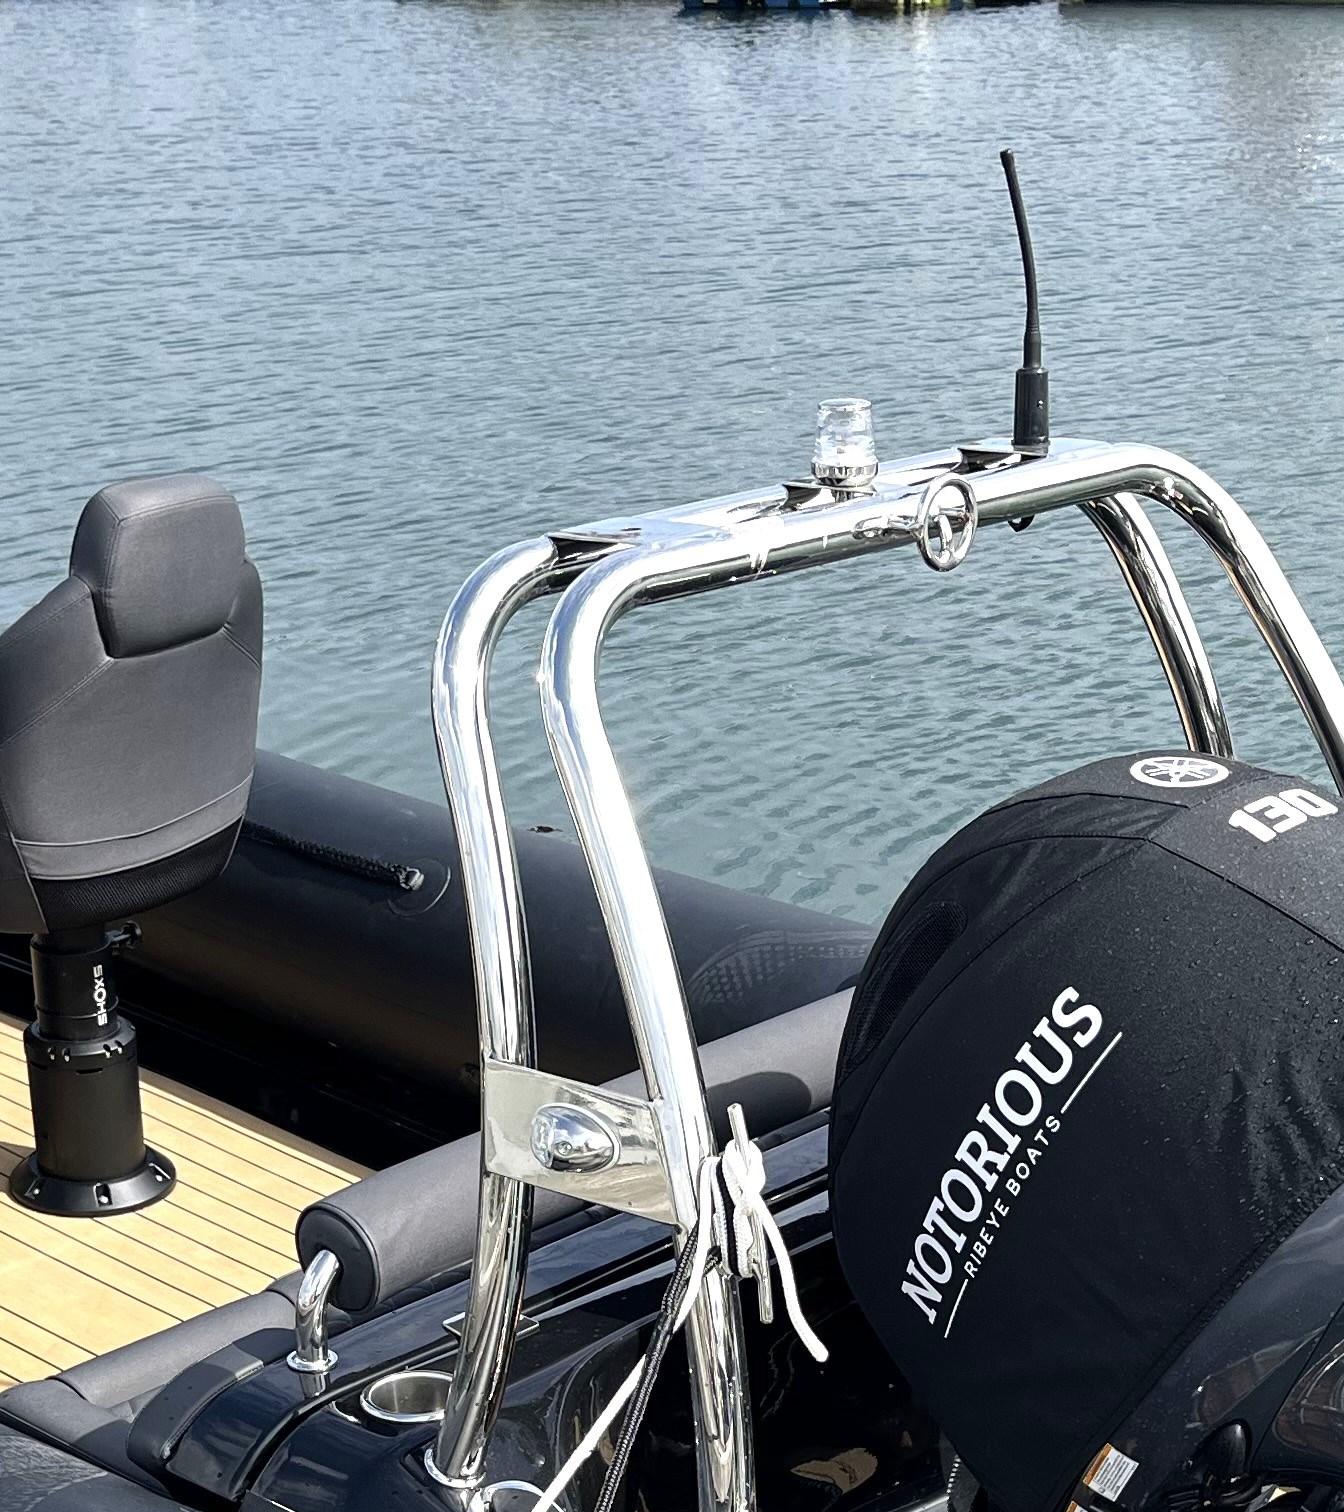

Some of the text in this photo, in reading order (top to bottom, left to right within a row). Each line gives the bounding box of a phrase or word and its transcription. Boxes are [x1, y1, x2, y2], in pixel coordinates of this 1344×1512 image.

[1228, 788, 1339, 843] 130
[92, 964, 108, 1027] SHOXS
[901, 985, 1104, 1325] NOTORIOUS
[963, 1115, 1061, 1279] RIBEYE BOATS
